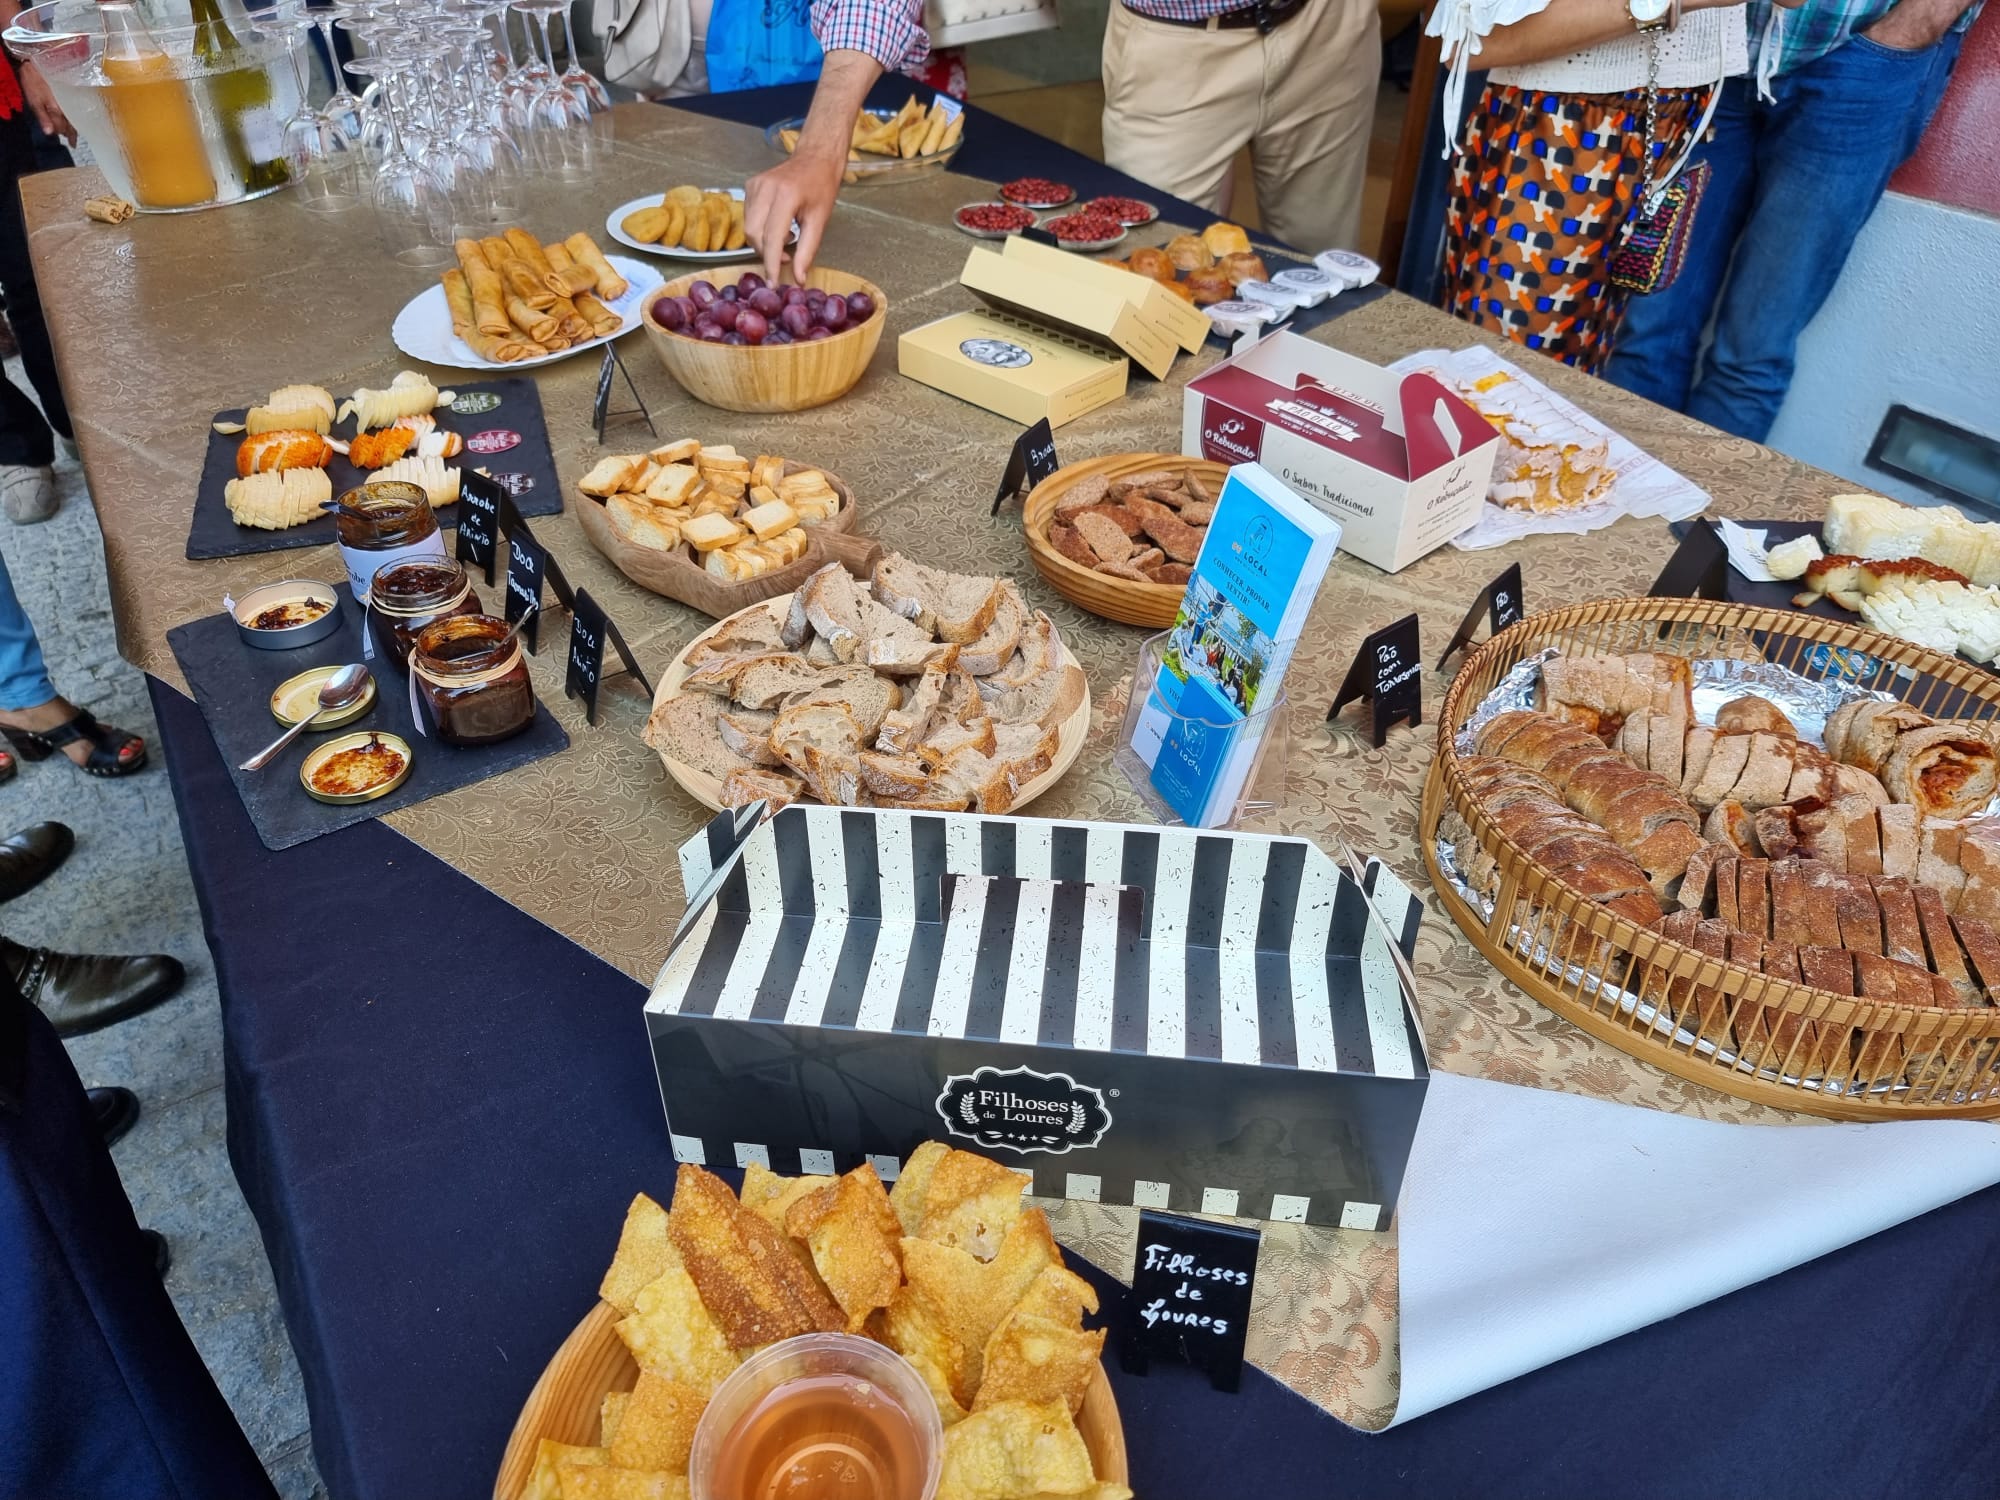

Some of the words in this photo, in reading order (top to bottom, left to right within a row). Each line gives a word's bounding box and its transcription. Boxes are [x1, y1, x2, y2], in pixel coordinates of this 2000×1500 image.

[1204, 428, 1213, 439] O
[1212, 432, 1256, 459] Rebuçado
[1282, 467, 1290, 479] O
[1291, 471, 1319, 492] Sabor
[1322, 484, 1375, 517] Tradicional
[1243, 551, 1269, 577] LOCAL
[978, 1089, 1069, 1113] Filhoses
[982, 1110, 996, 1120] de
[1003, 1107, 1064, 1126] Loures
[1144, 1243, 1248, 1286] Filhoses
[1174, 1281, 1203, 1301] de
